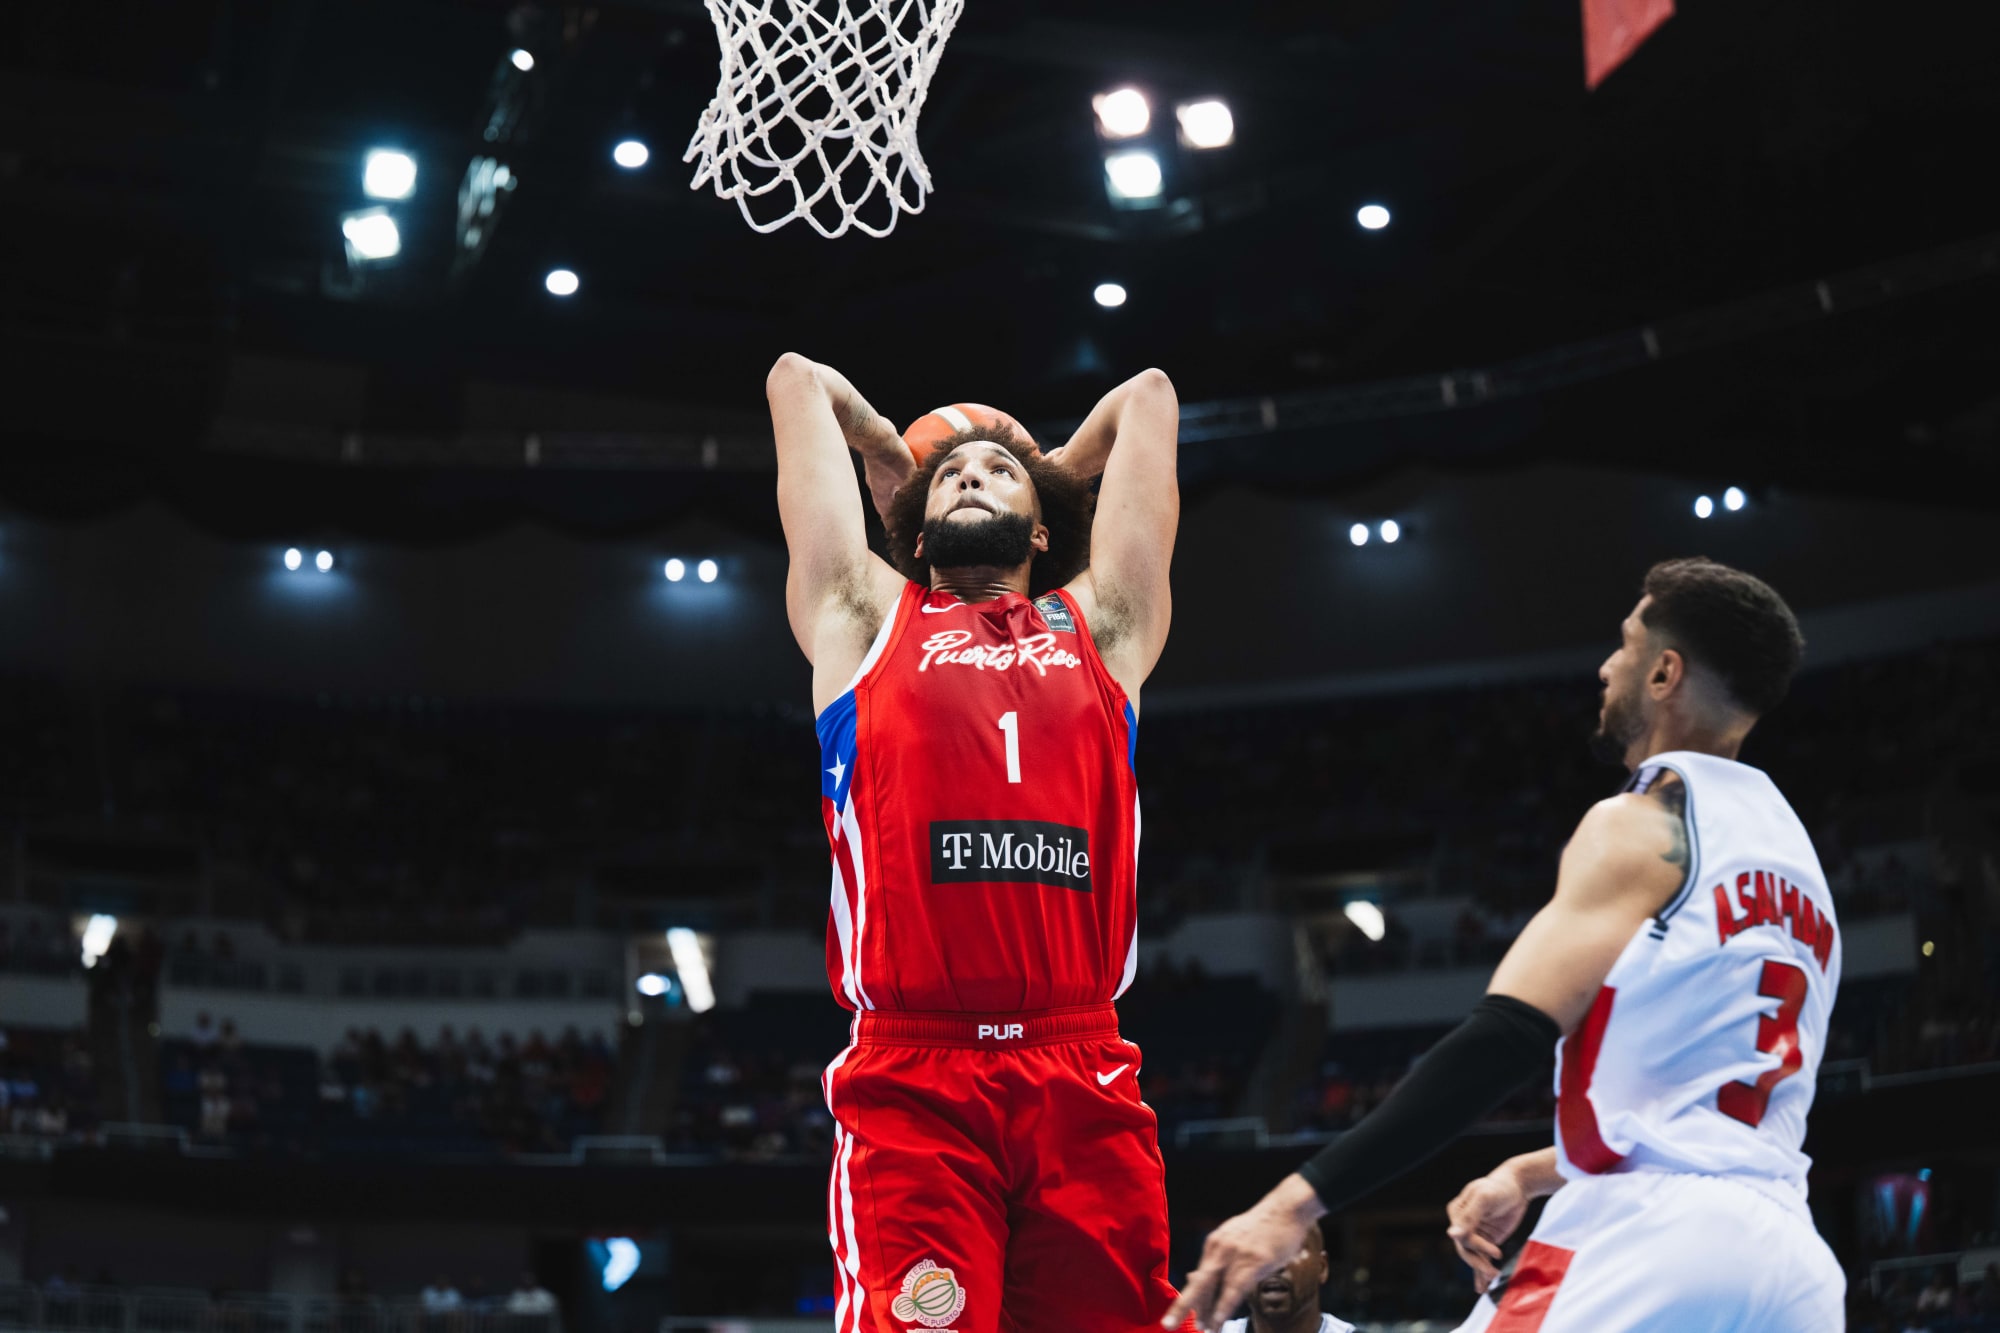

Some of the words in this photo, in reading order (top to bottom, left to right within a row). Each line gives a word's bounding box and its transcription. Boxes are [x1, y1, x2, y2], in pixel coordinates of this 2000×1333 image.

[1046, 612, 1067, 621] FIBA
[918, 630, 1017, 672] Puerto
[1017, 633, 1081, 676] Rico
[998, 711, 1022, 783] 1
[979, 833, 1090, 878] Mobile
[978, 1023, 1024, 1040] PUR
[1717, 959, 1808, 1129] 3
[903, 1261, 935, 1291] LOTERÍA
[919, 1314, 930, 1324] DE
[930, 1310, 958, 1326] PUERTO
[956, 1289, 964, 1309] RICO
